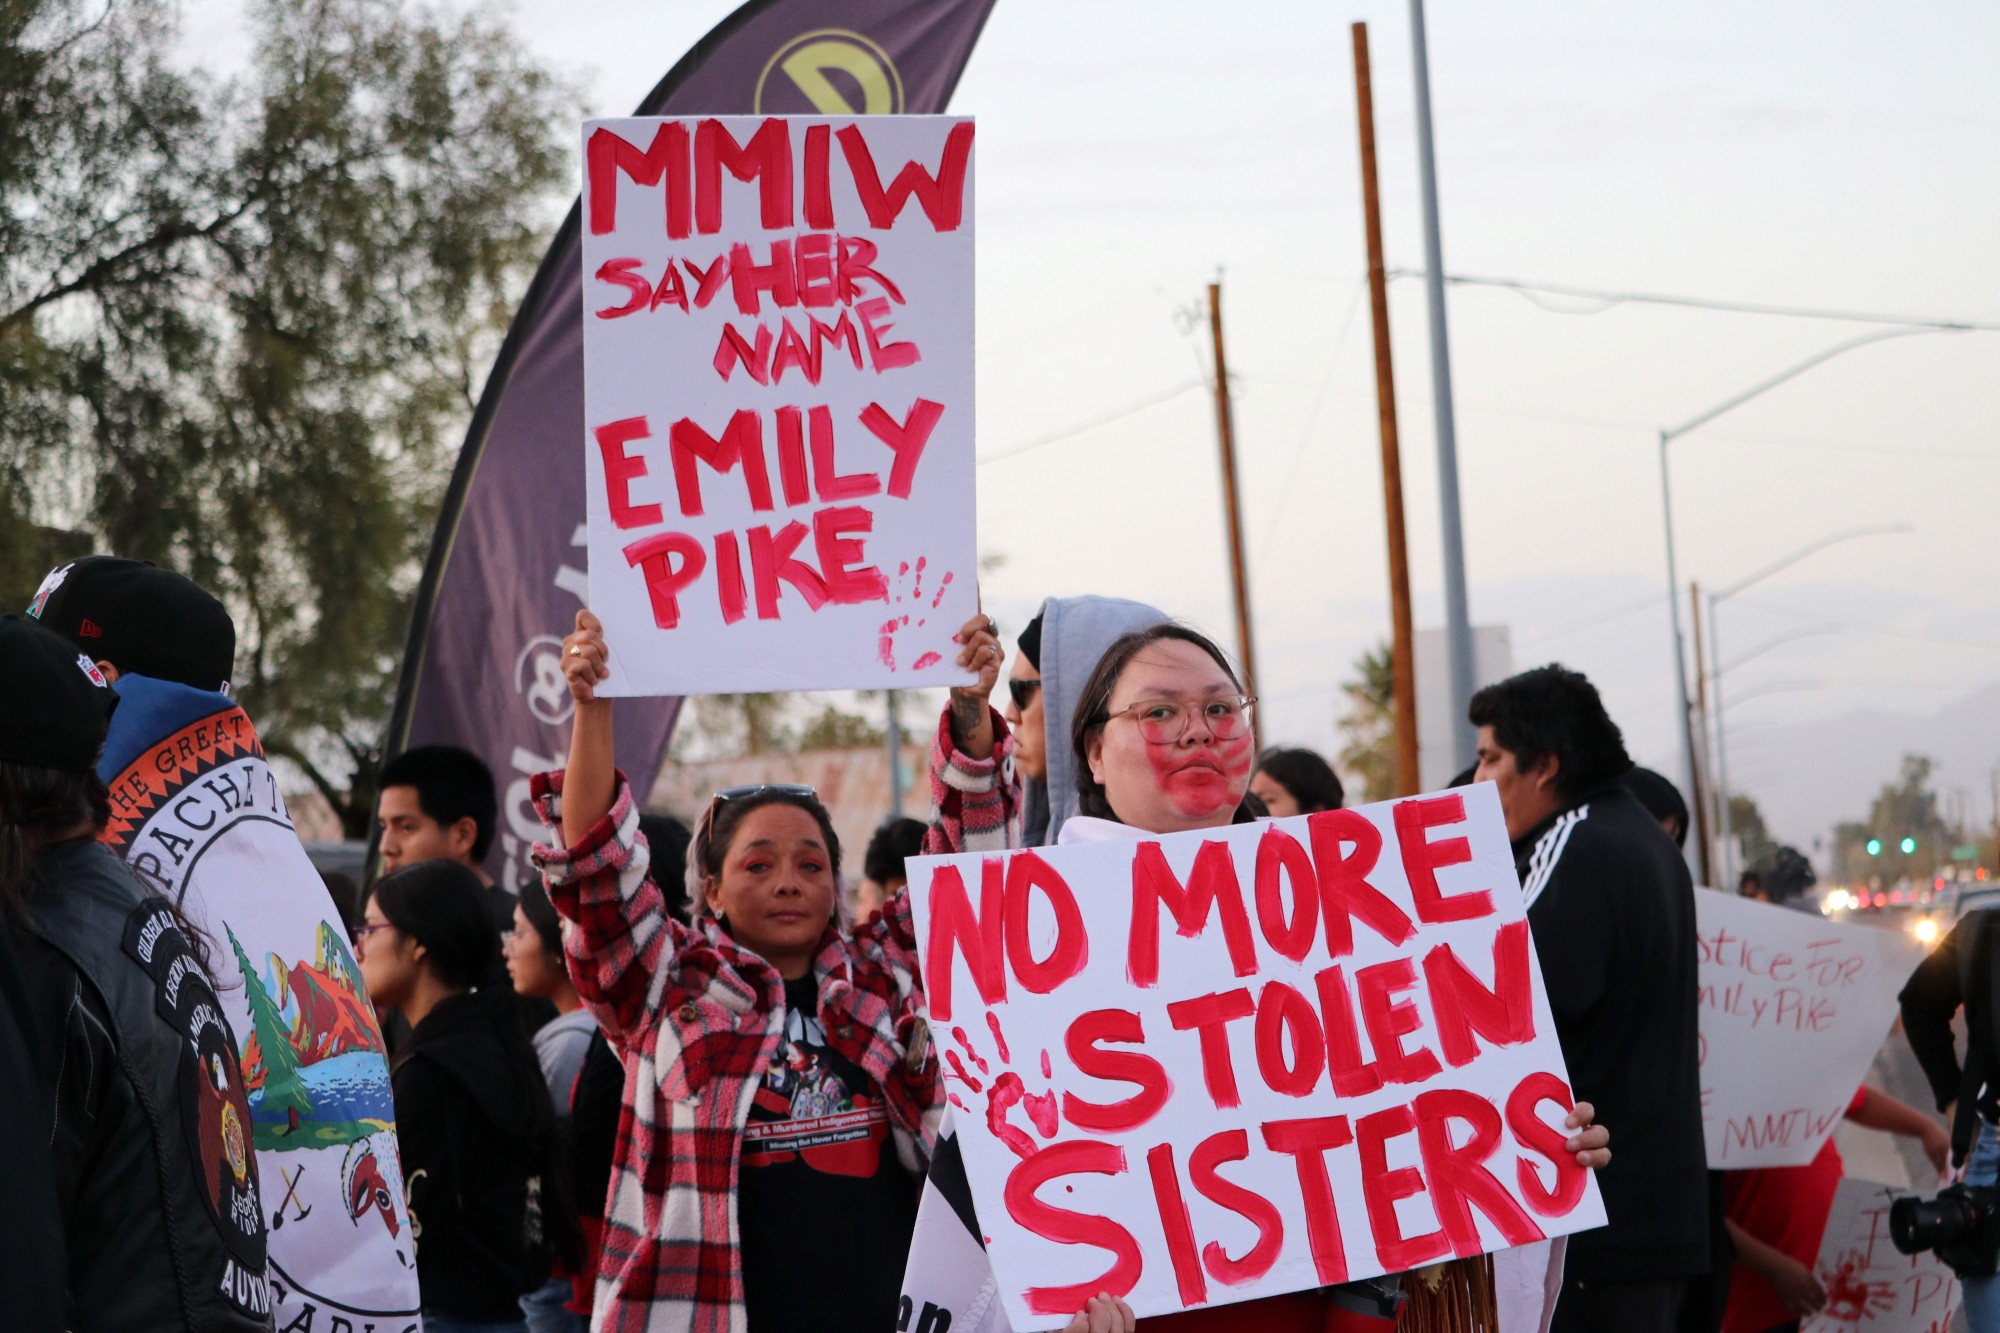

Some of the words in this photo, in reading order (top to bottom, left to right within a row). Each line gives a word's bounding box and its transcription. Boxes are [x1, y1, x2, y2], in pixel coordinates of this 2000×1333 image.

[587, 117, 975, 240] MMIW
[713, 297, 922, 387] NAME
[592, 397, 945, 530] EMILY
[622, 506, 890, 630] PIKE
[111, 770, 150, 823] HE
[155, 715, 243, 774] GREAT
[134, 765, 254, 890] PACHE
[924, 848, 1088, 1021] NO
[1127, 793, 1496, 988] MORE
[1063, 917, 1536, 1134] STOLEN
[762, 1125, 770, 1134] &
[772, 1119, 818, 1133] Murdered
[819, 1111, 869, 1128] Indigenous
[769, 1139, 798, 1150] Missing
[811, 1135, 832, 1145] Never
[833, 1130, 868, 1142] Forgotten
[1722, 1104, 1843, 1160] MMIW
[1004, 1072, 1587, 1315] SISTERS
